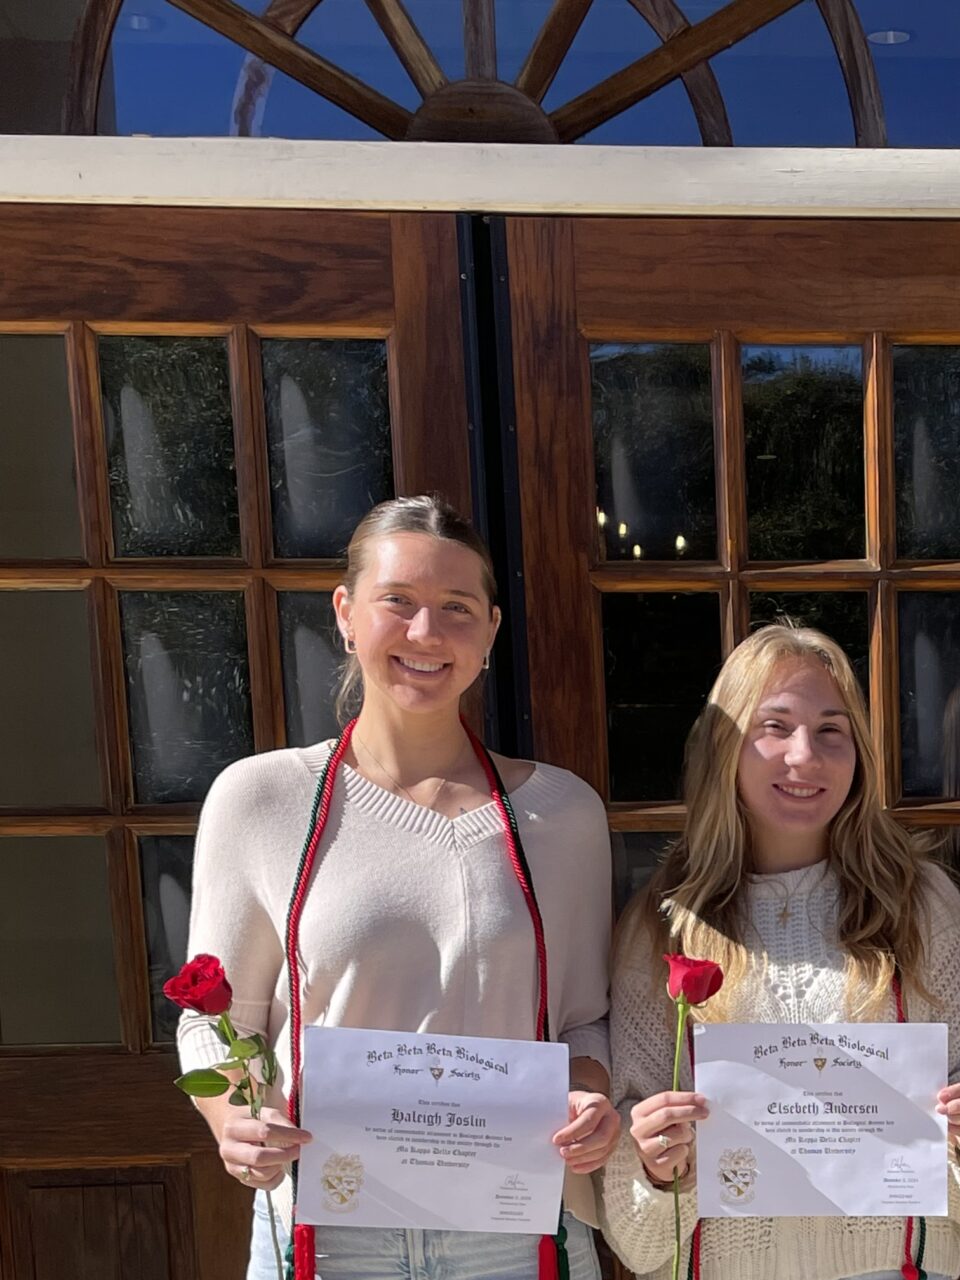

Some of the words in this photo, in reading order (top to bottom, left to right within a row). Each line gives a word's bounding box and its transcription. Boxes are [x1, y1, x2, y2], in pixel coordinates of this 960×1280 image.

[753, 1045, 778, 1061] Beta
[782, 1036, 807, 1048] Beta
[810, 1033, 835, 1046] Beta
[838, 1035, 889, 1060] Biological
[367, 1051, 393, 1066] Beta
[397, 1044, 423, 1056] Beta
[426, 1043, 452, 1057] Beta
[455, 1047, 508, 1075] Biological
[779, 1057, 807, 1068] Honor
[831, 1058, 862, 1068] Society
[393, 1065, 424, 1075] Honor
[448, 1069, 481, 1080] Society
[768, 1102, 819, 1115] Elsebeth
[823, 1102, 878, 1114] Andersen
[392, 1108, 441, 1126] Haleigh
[445, 1112, 486, 1127] Joslin
